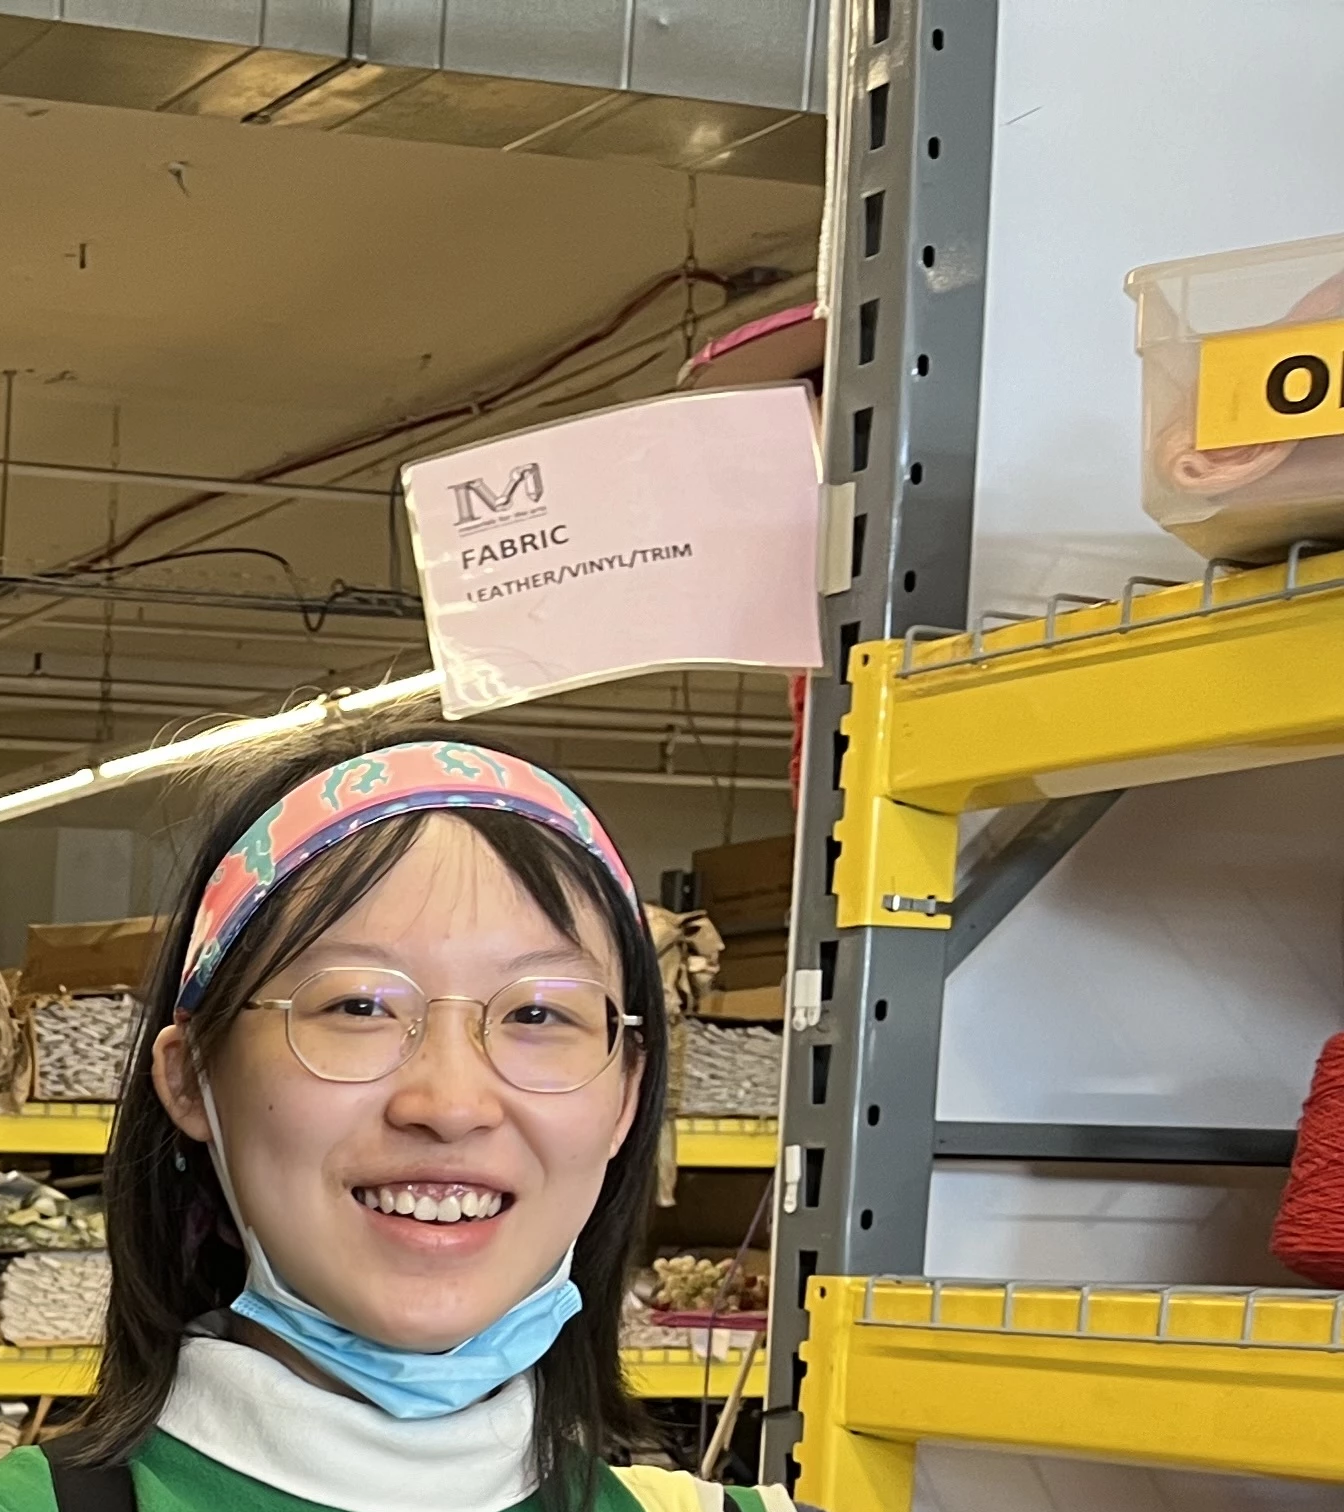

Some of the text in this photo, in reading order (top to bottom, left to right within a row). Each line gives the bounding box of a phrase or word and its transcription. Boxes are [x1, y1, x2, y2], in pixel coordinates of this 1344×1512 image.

[1265, 350, 1344, 416] O
[461, 524, 570, 570] FABRIC
[466, 543, 693, 603] LEATHER/VINYL/TRIM
